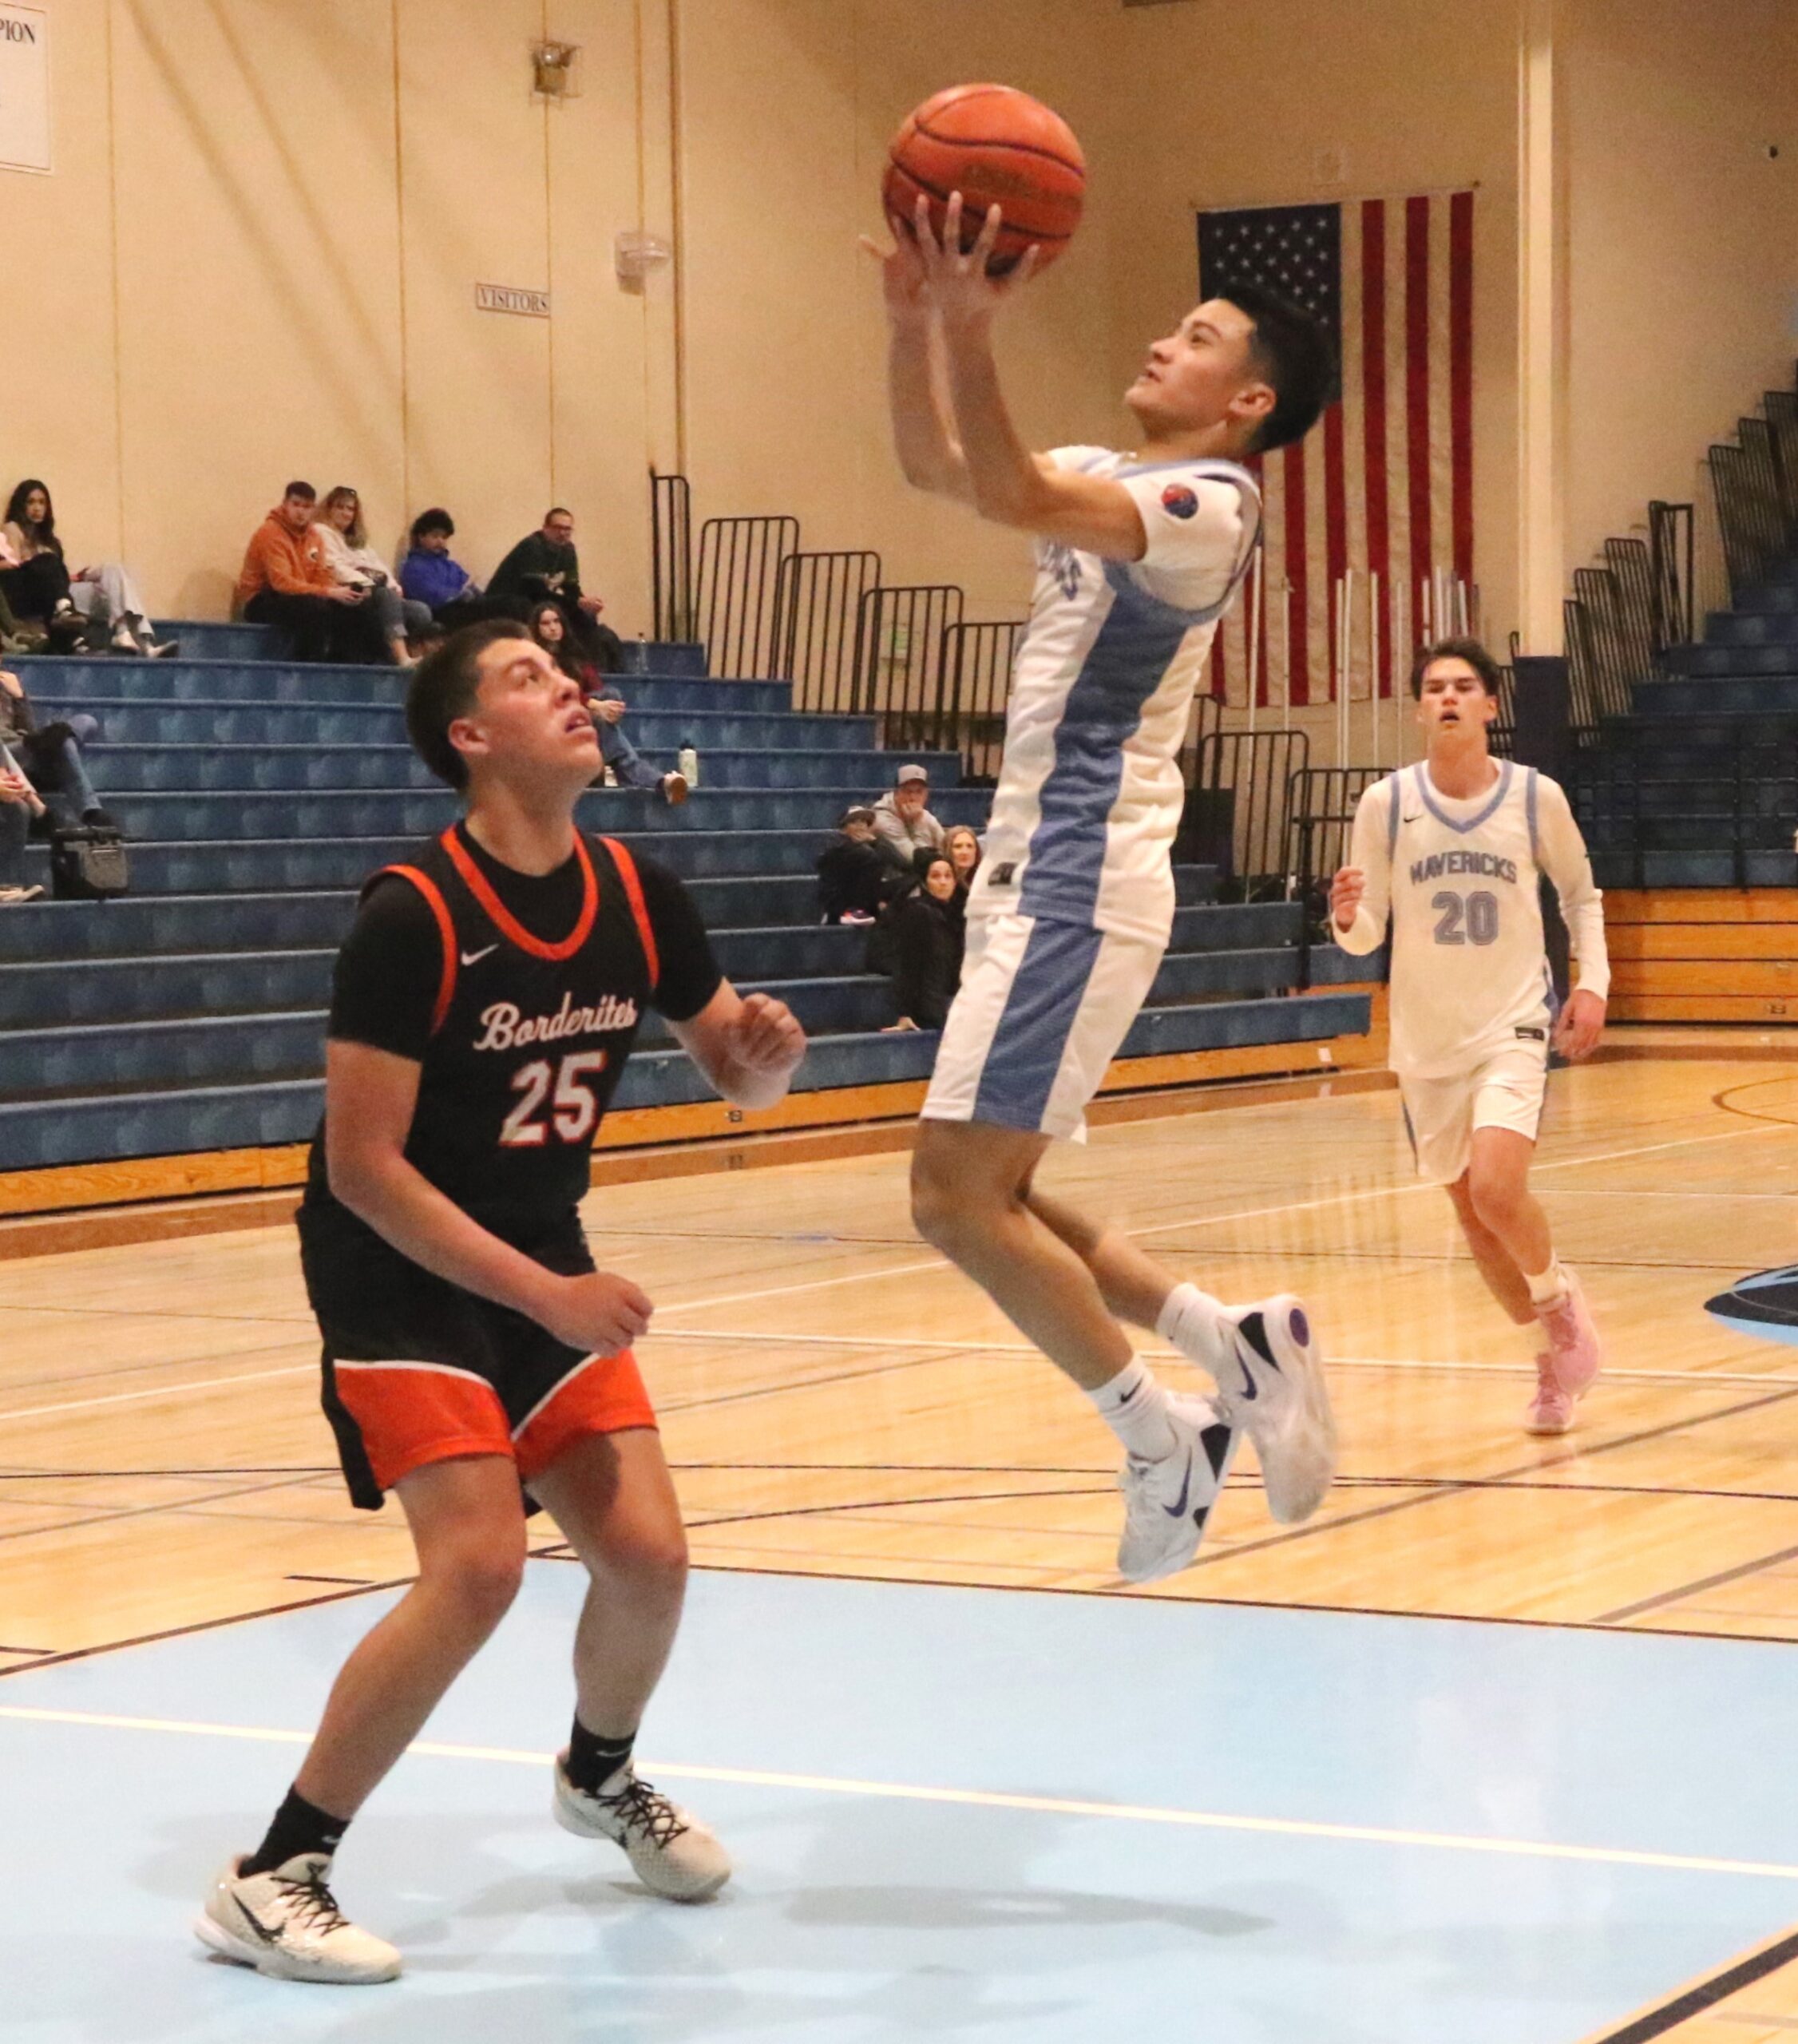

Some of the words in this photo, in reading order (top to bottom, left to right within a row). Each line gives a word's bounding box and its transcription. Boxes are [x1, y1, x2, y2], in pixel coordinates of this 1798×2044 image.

[480, 287, 548, 312] VISITORS
[1410, 850, 1517, 885] MAVERICKS
[1432, 891, 1499, 945] 20
[473, 991, 637, 1050] Borderites
[499, 1049, 608, 1147] 25
